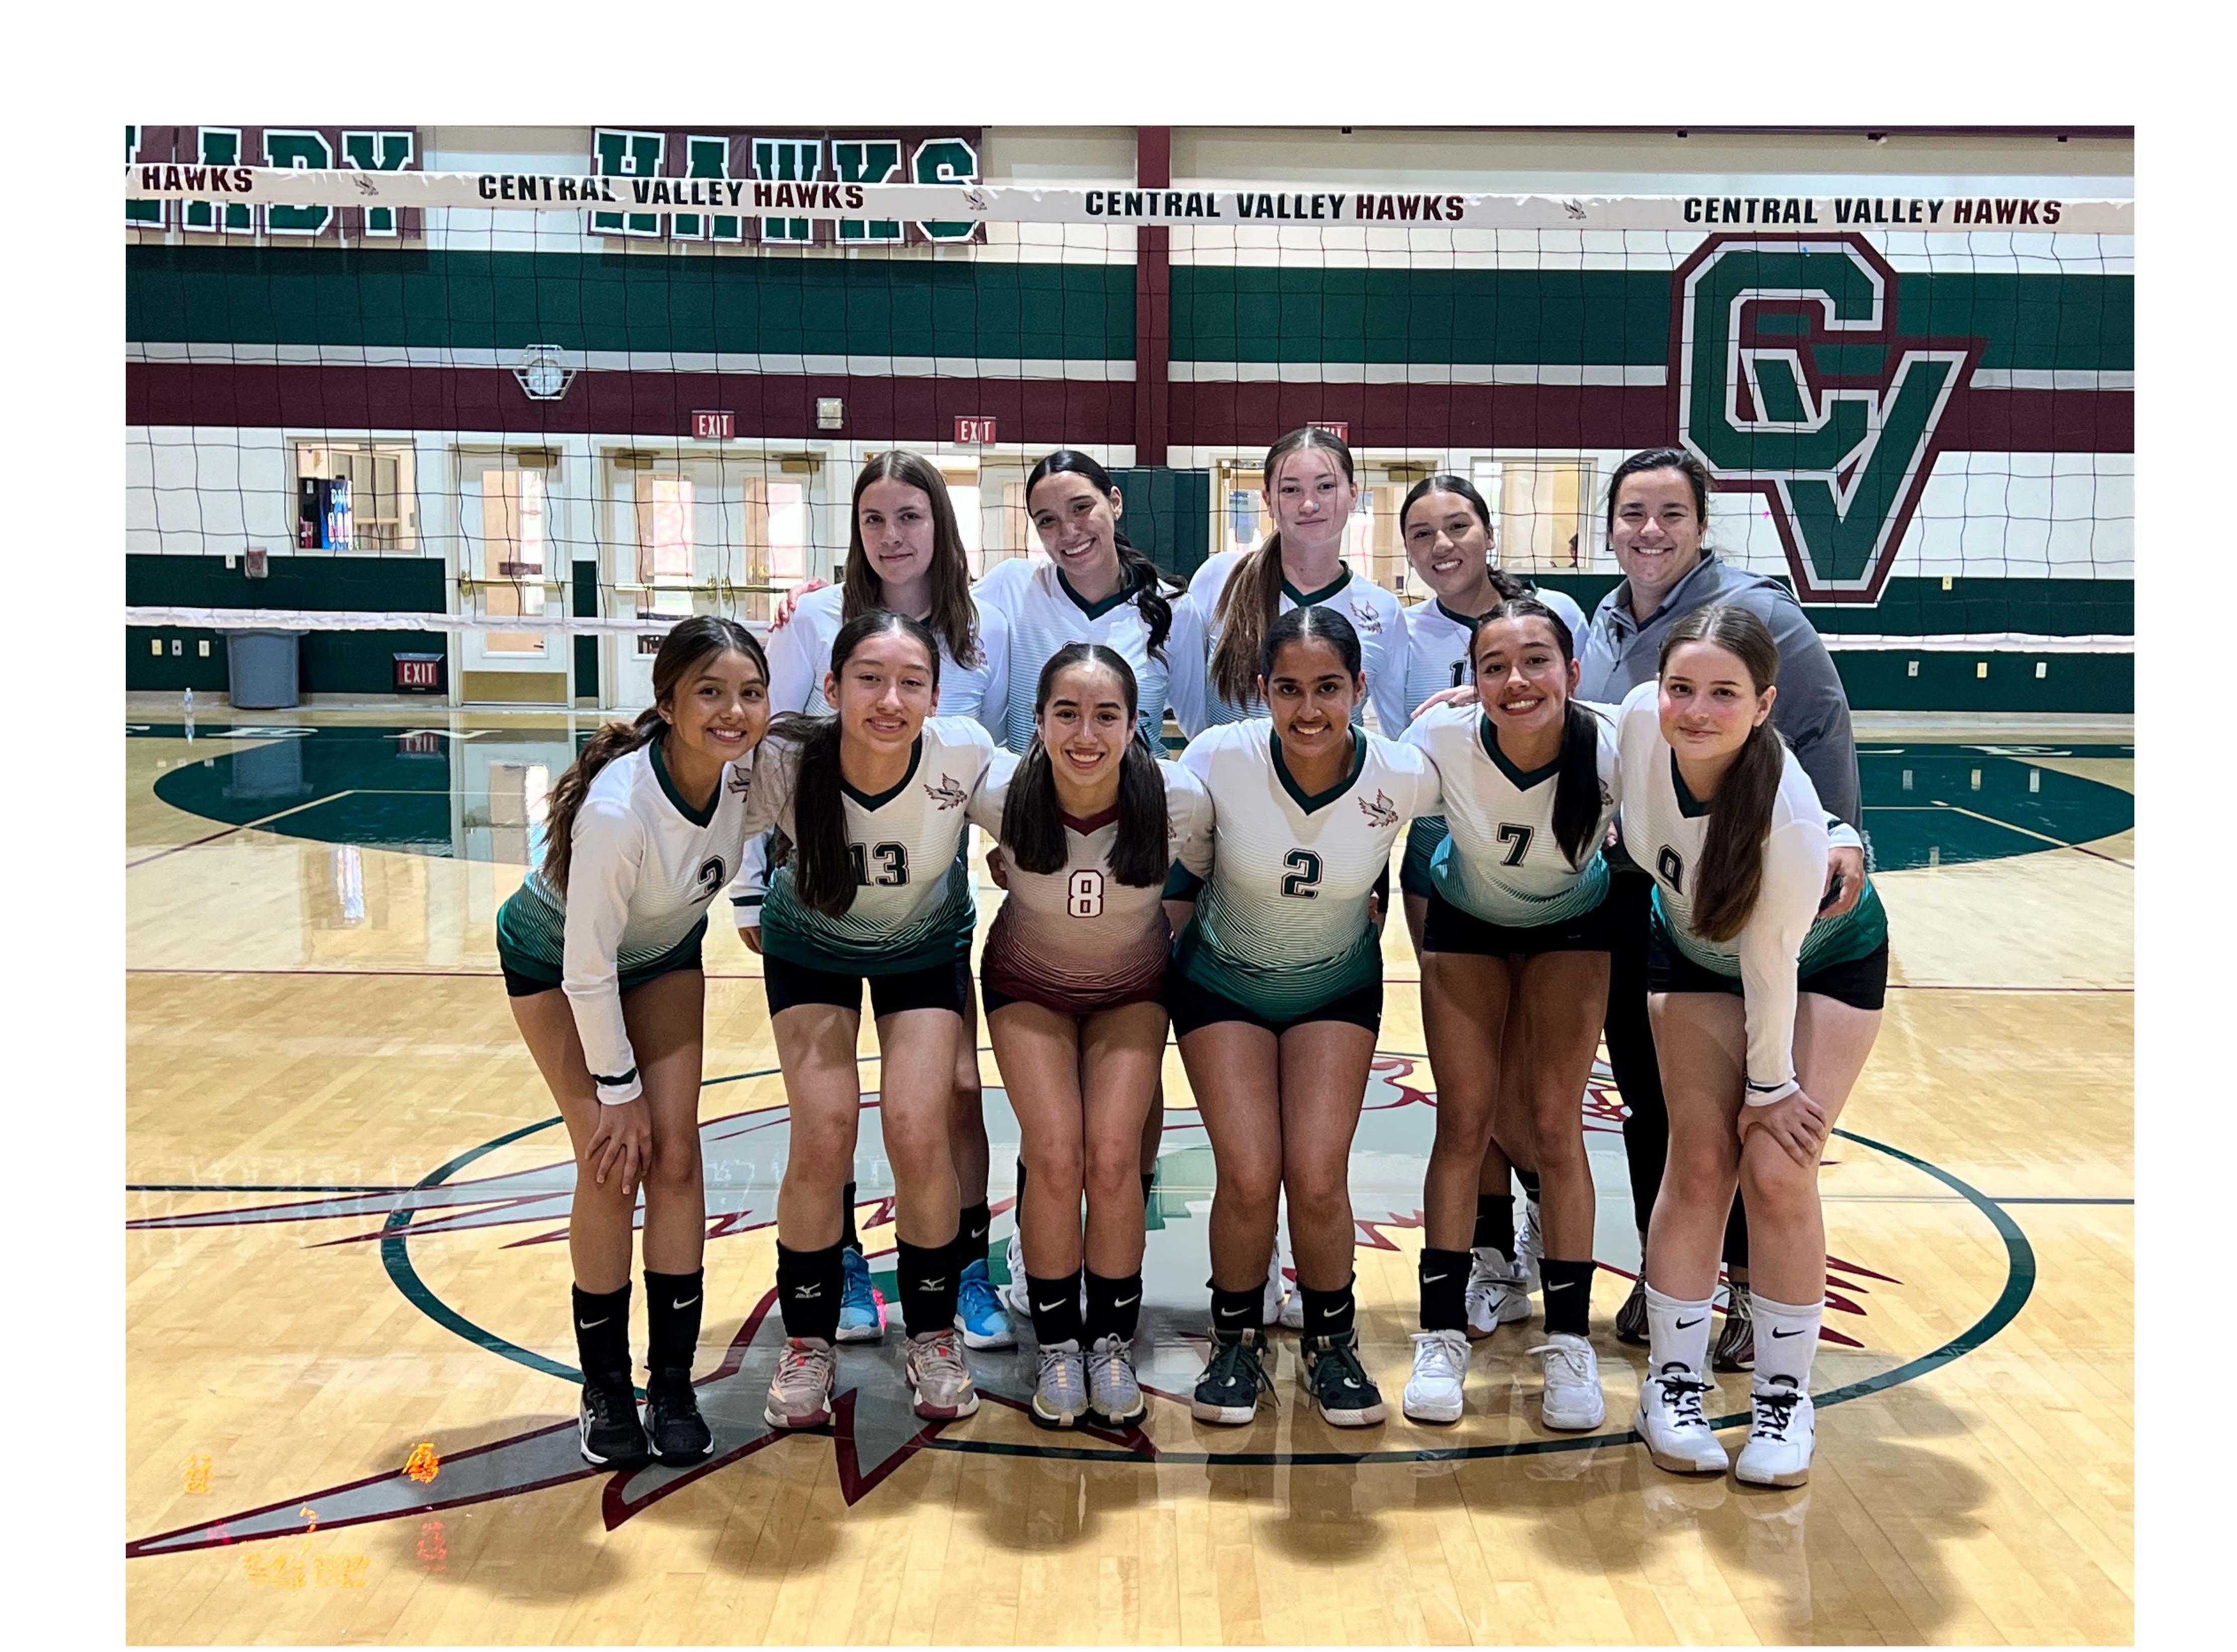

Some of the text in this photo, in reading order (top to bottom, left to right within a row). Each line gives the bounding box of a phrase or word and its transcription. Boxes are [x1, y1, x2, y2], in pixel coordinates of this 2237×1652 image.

[142, 166, 253, 192] HAWKS
[478, 175, 864, 209] CENTRAL VALLEY HAWKS
[590, 127, 979, 244] HAWKS
[1085, 190, 1465, 221] CENTRAL VALLEY HAWKS
[1684, 197, 2062, 225] CENTRAL VALLEY HAWKS
[698, 415, 729, 436] EXIT
[961, 421, 991, 442] EXIT
[1671, 233, 1985, 603] CV
[404, 663, 434, 683] EXIT
[1497, 822, 1534, 868] 7
[847, 841, 910, 887] 13
[1281, 848, 1323, 899] 2
[1067, 869, 1104, 918] 8
